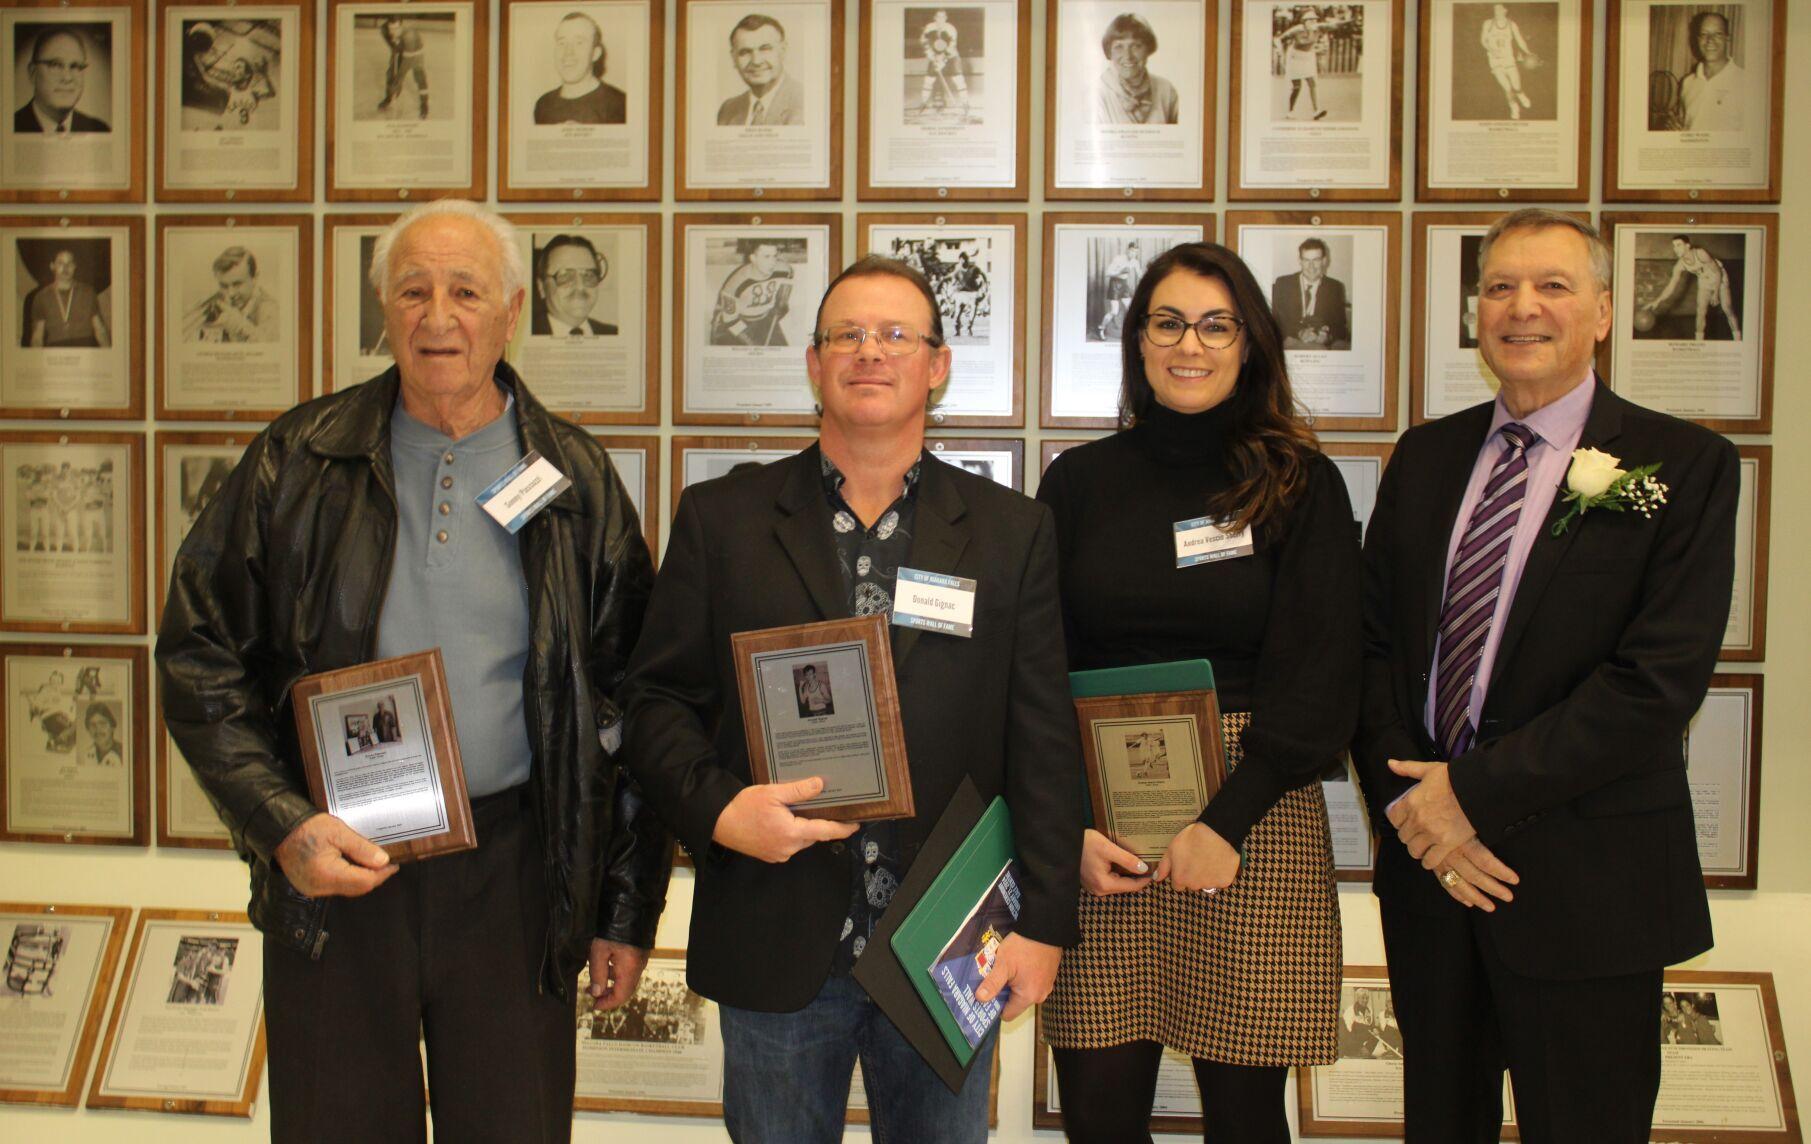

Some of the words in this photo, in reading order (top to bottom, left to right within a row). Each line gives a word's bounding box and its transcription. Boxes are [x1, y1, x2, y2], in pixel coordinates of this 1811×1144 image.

[1184, 538, 1204, 547] Andrea
[912, 594, 933, 606] Donald
[934, 599, 956, 610] Gignac
[910, 617, 926, 626] SPORTS
[943, 622, 955, 631] FAME
[941, 965, 956, 989] FALLS
[951, 984, 971, 1016] NIAGARA
[962, 984, 976, 1006] WALL
[966, 1012, 976, 1024] OF
[972, 1001, 991, 1029] SPORTS
[971, 1023, 985, 1038] CITY
